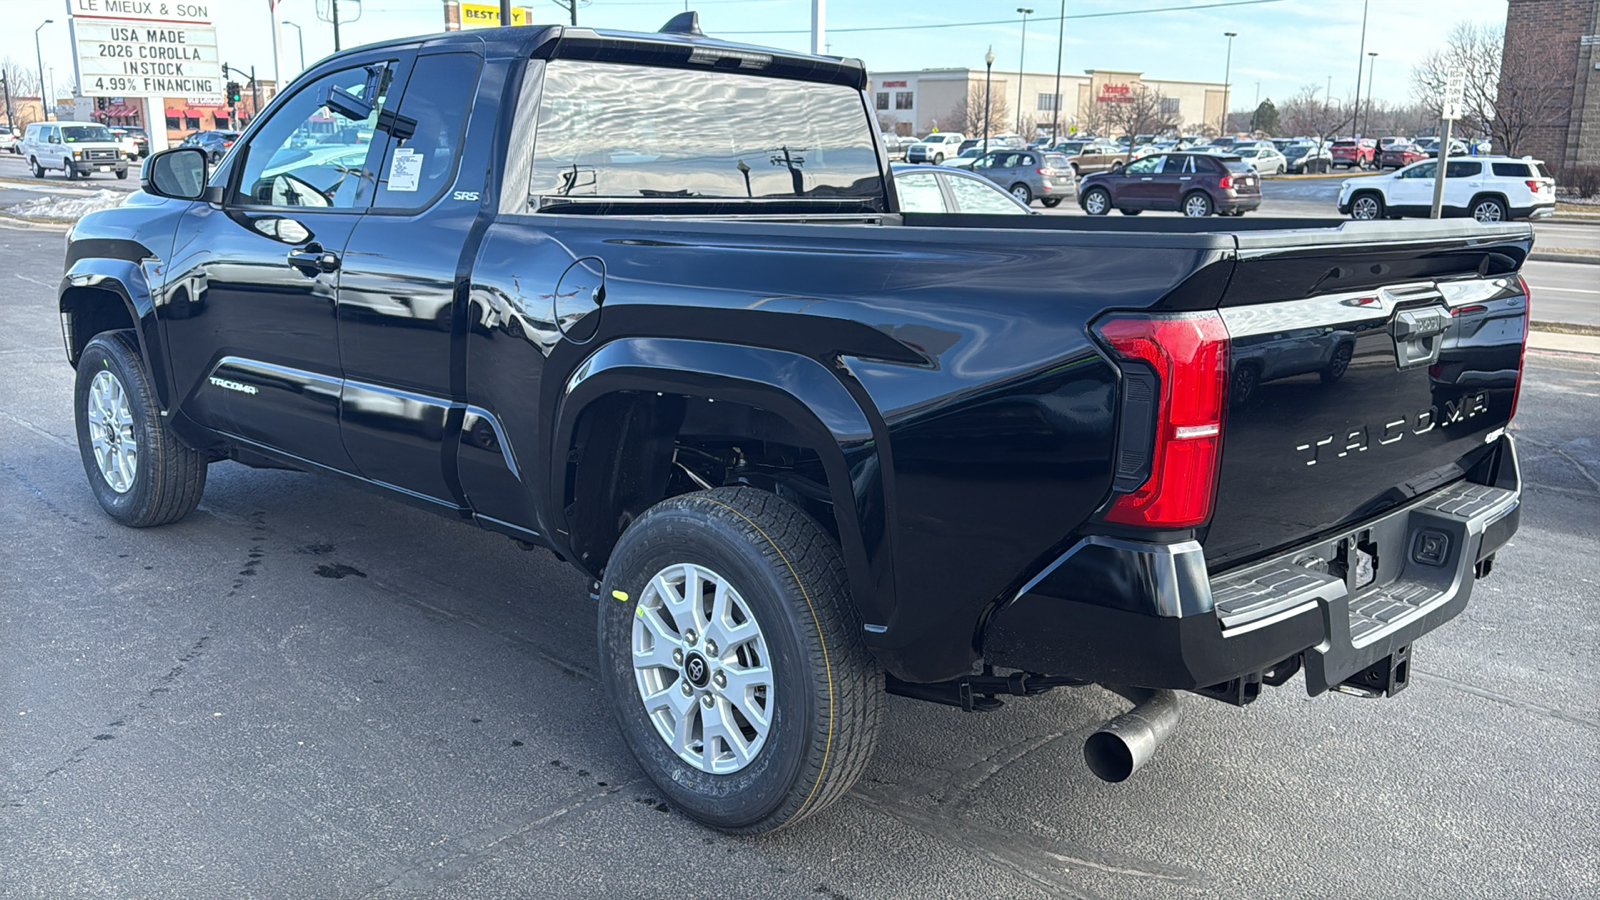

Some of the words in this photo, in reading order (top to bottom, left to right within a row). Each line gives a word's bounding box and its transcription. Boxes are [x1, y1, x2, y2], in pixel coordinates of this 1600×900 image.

[79, 0, 98, 11] LE
[105, 0, 153, 15] MIEUX
[159, 3, 169, 15] &
[177, 4, 208, 17] SON
[466, 9, 494, 20] BEST
[111, 27, 139, 42] USA
[147, 29, 186, 44] MADE
[98, 44, 133, 58] 2026
[139, 45, 201, 60] COROLLA
[95, 77, 137, 92] 4.99%
[144, 78, 213, 93] FINANCING
[453, 190, 480, 202] SR5
[209, 376, 258, 395] TACOMA
[1295, 388, 1490, 467] TACOMA
